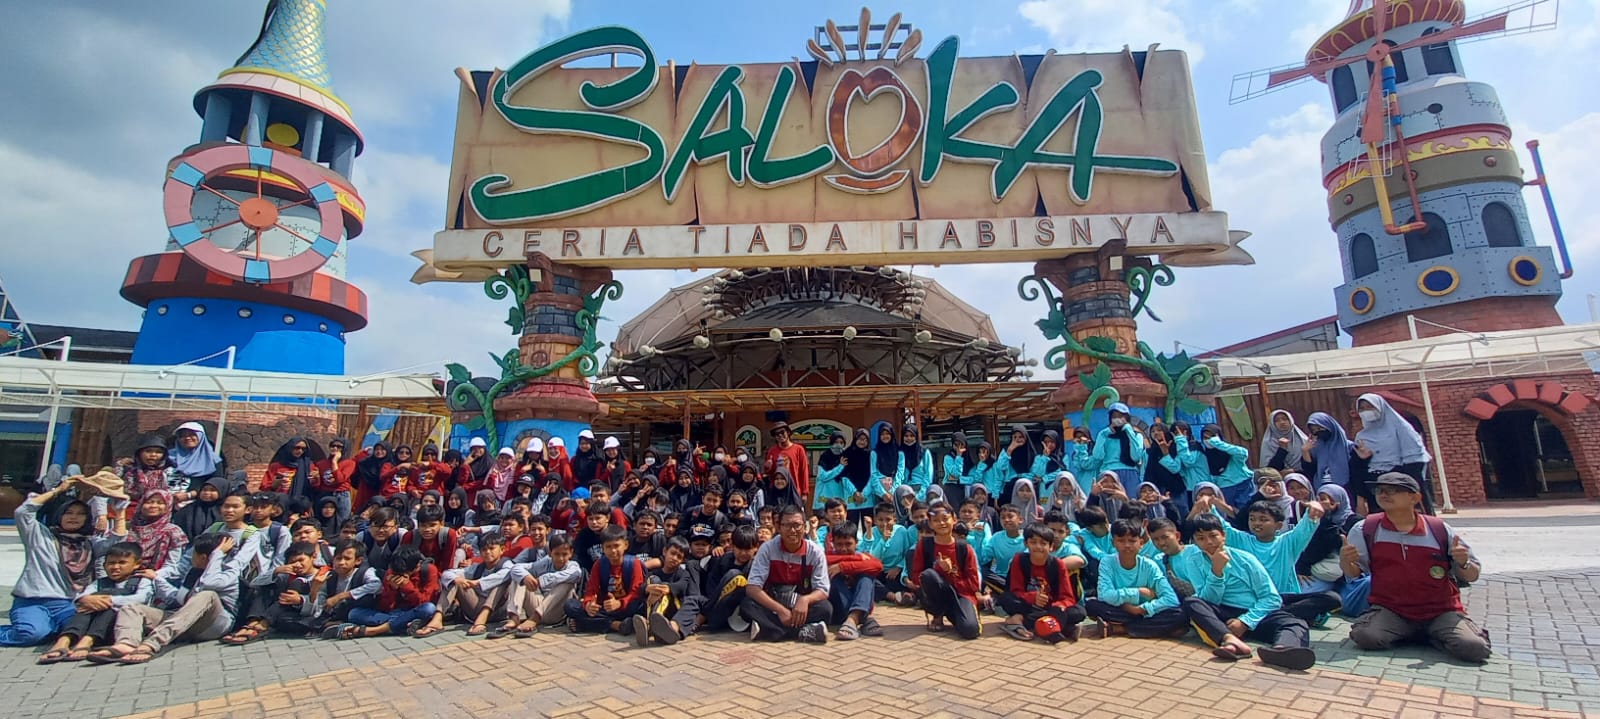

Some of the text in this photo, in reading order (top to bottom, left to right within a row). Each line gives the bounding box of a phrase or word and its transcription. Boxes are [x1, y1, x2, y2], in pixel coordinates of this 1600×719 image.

[470, 26, 1180, 224] SALOKA
[482, 215, 1175, 258] CERIA TIADA HABISNYA
